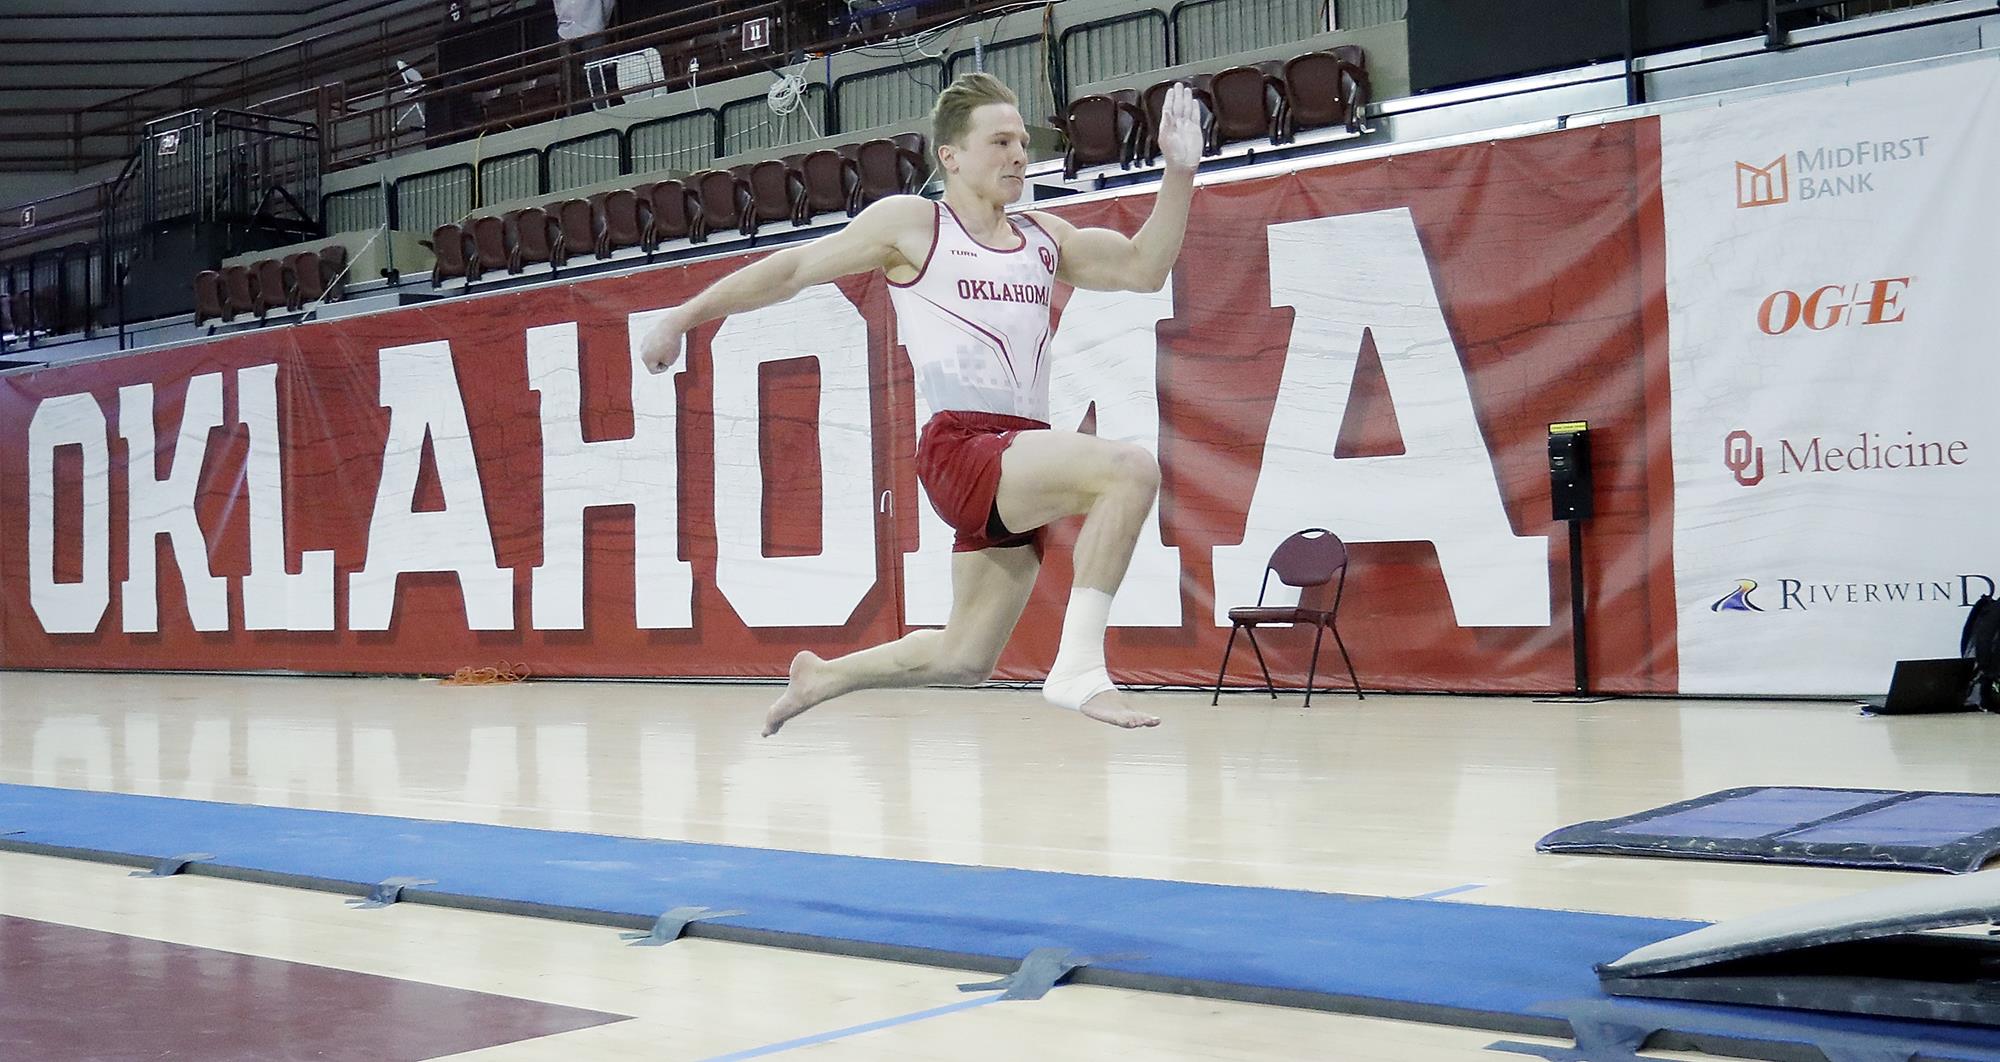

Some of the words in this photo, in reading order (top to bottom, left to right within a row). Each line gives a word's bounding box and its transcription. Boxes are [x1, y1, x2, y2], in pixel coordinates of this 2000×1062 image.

[1799, 171, 1875, 201] BANK
[1724, 430, 1764, 486] OU
[1778, 431, 1969, 474] Medicine
